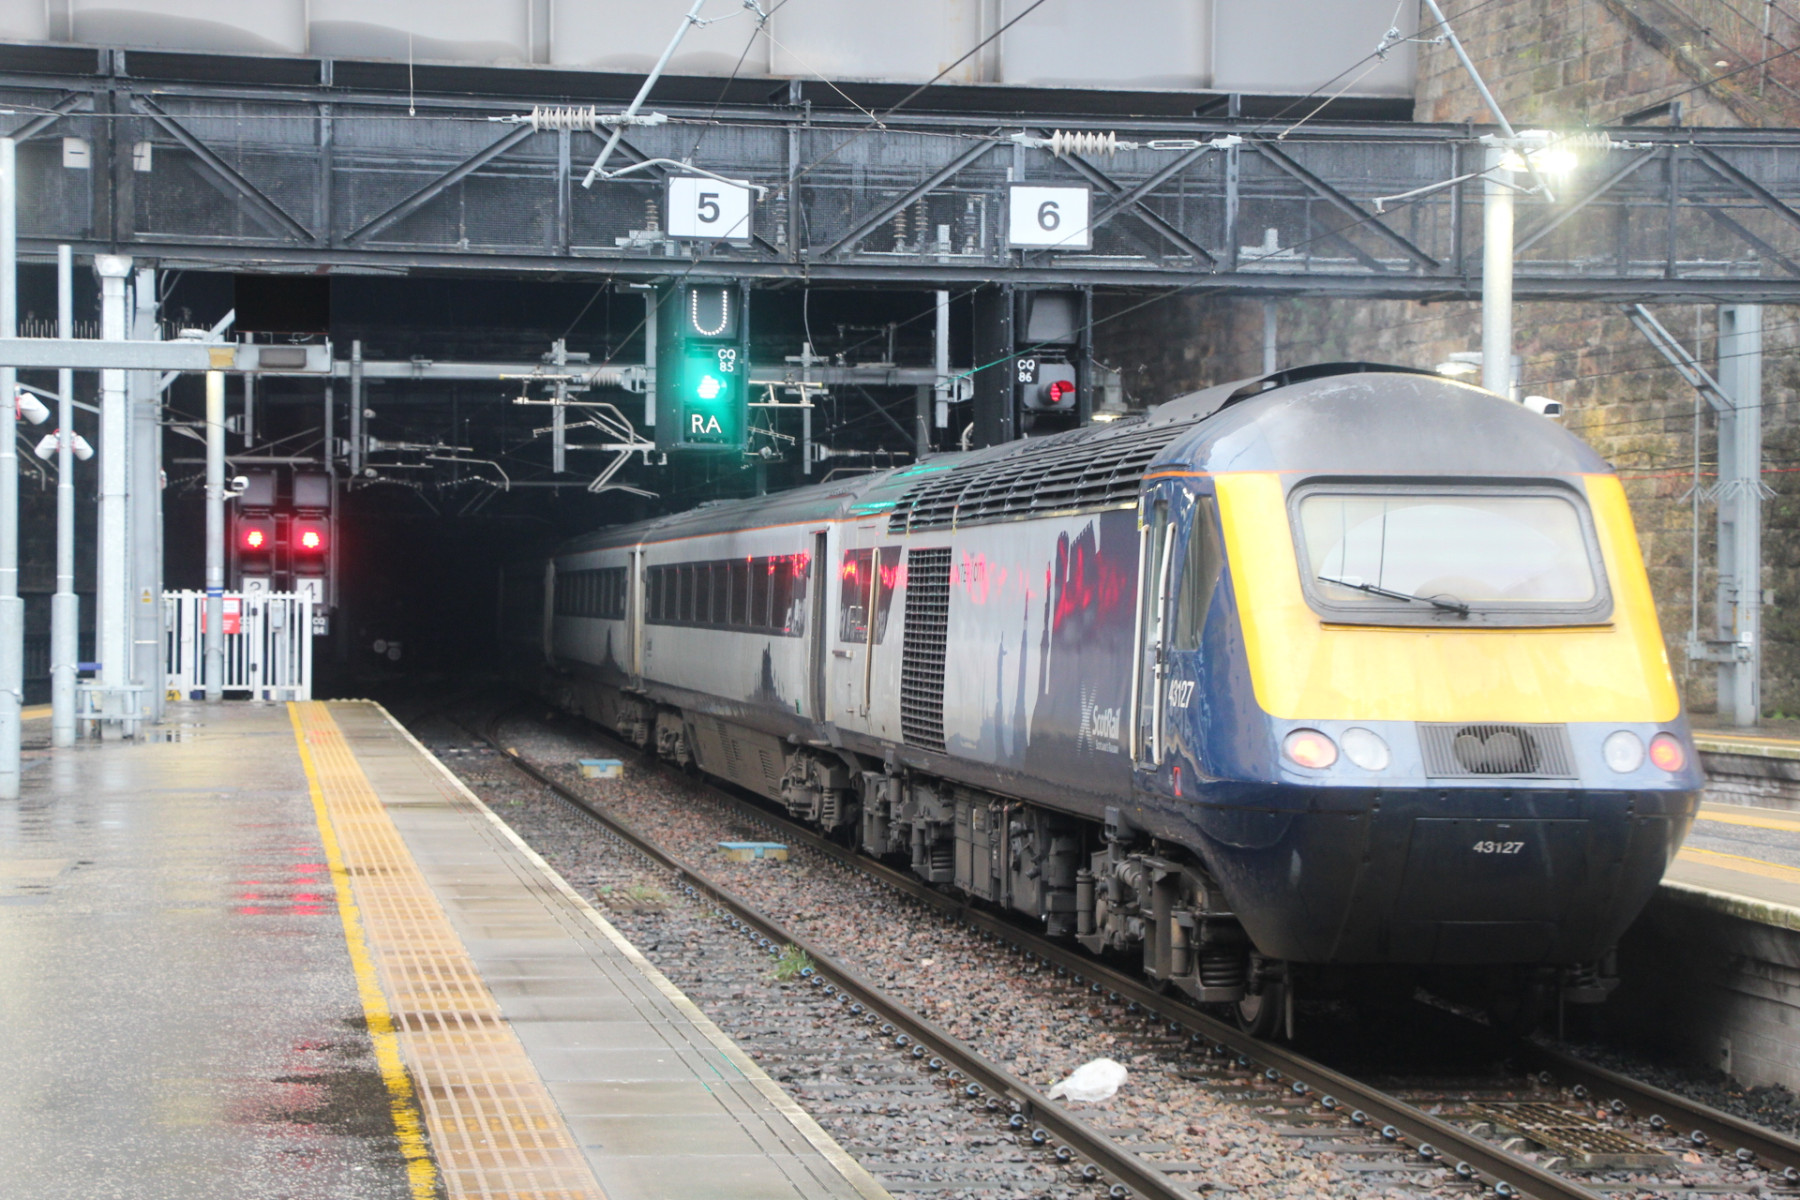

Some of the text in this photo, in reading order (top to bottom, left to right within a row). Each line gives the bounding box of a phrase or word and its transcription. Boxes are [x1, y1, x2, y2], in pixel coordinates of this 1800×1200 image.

[698, 192, 720, 223] 5
[1037, 201, 1060, 232] 6
[692, 290, 727, 336] U
[718, 349, 736, 361] CQ
[719, 361, 734, 372] 85
[1017, 359, 1035, 371] CQ
[1018, 371, 1032, 382] 86
[691, 414, 722, 433] RA
[1168, 679, 1195, 709] 43127
[1092, 704, 1121, 740] ScotRail
[1472, 840, 1525, 854] 43127
